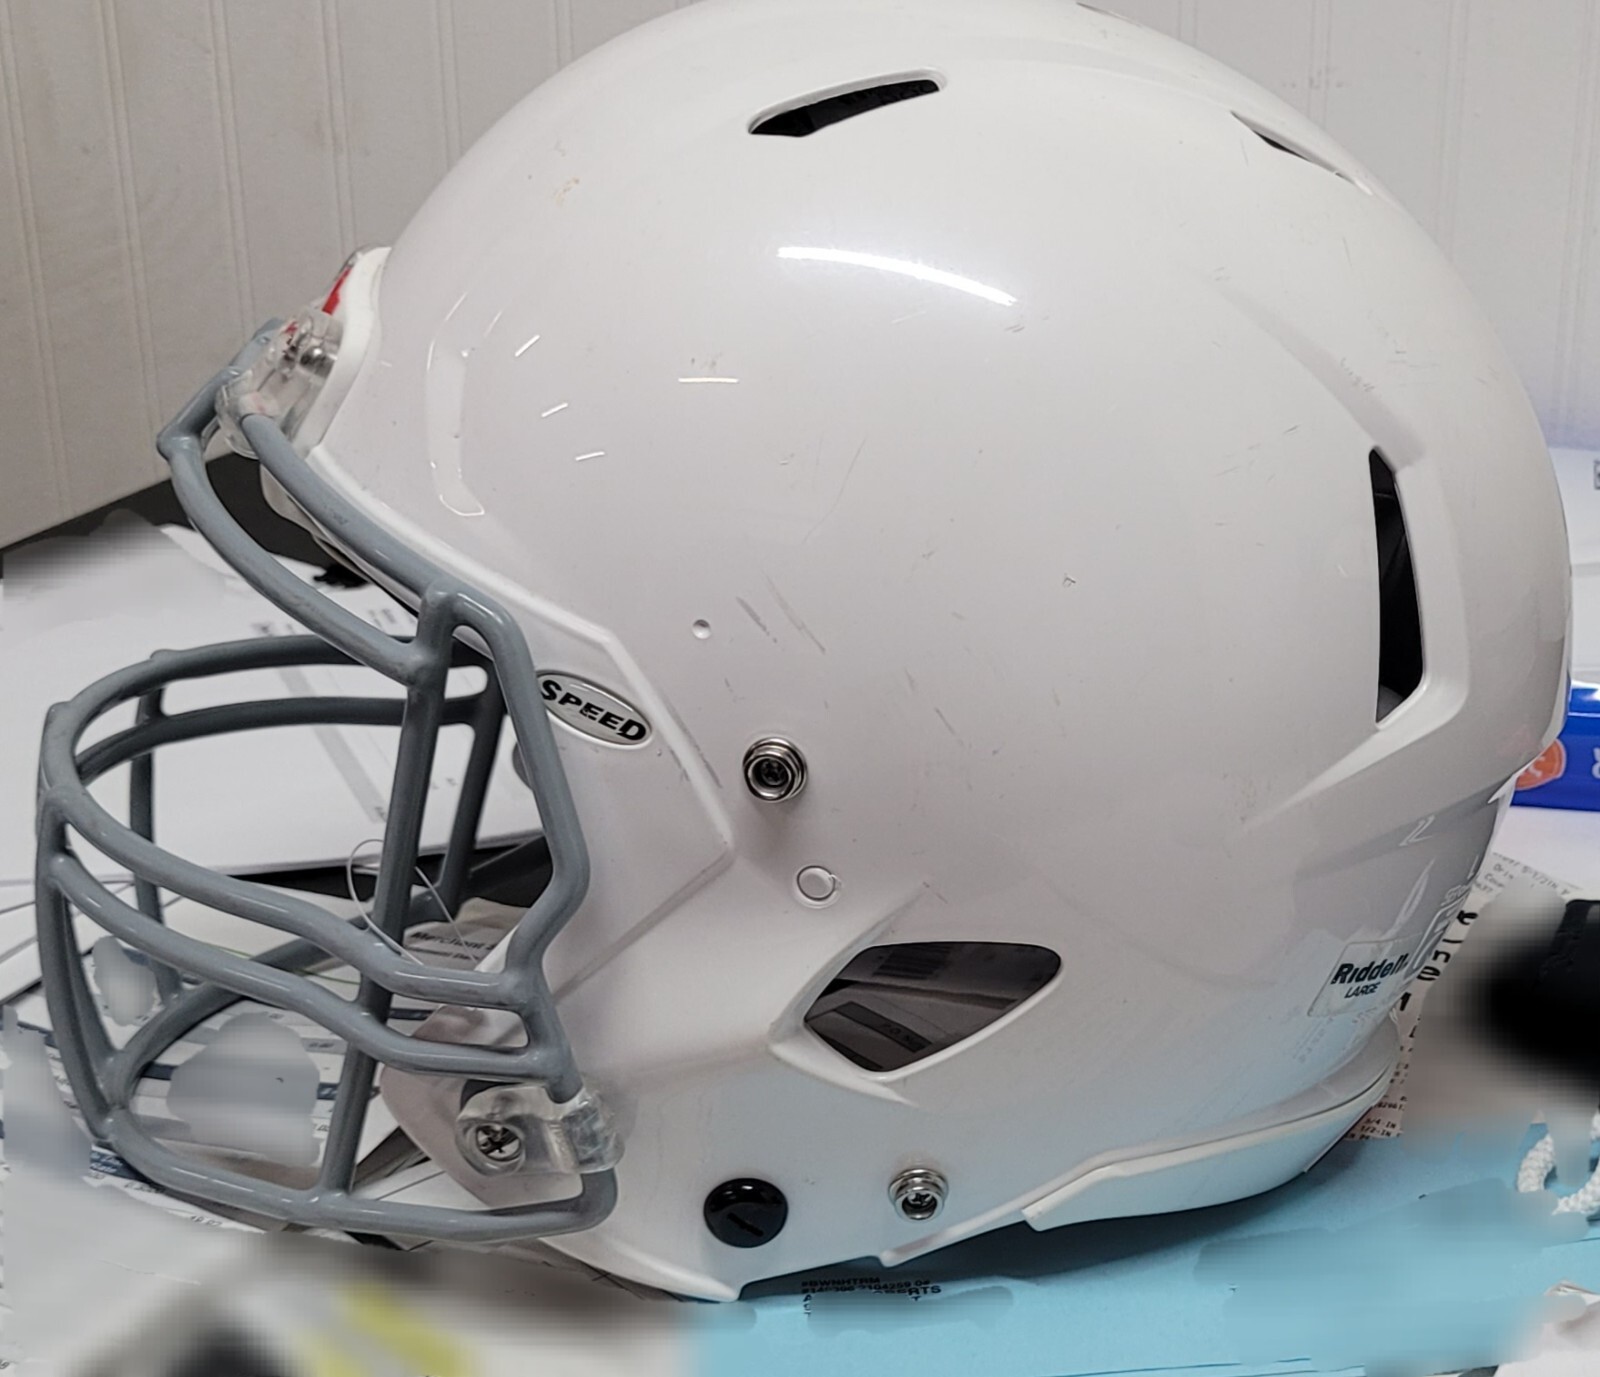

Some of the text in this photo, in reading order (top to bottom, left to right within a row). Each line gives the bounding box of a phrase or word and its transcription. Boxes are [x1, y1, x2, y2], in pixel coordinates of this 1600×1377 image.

[541, 679, 646, 741] SPEED
[1330, 953, 1409, 985] Riddell
[1344, 981, 1381, 999] LARGE
